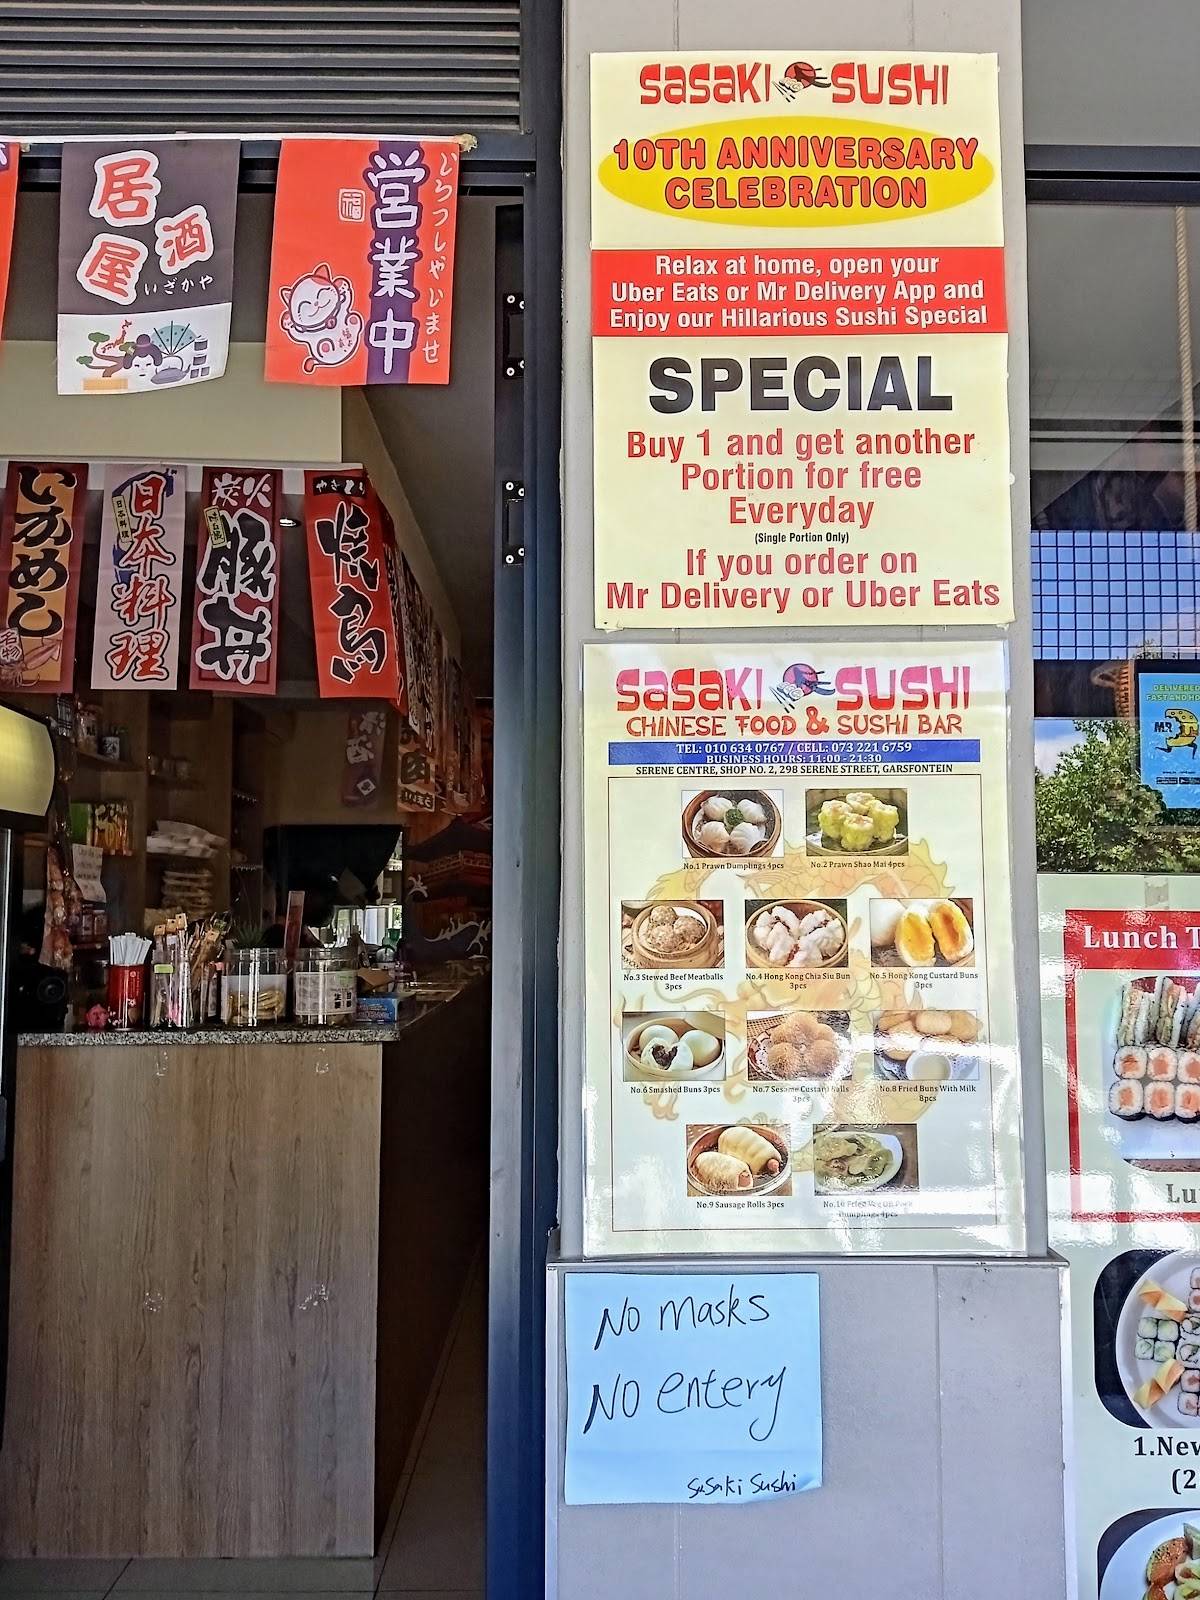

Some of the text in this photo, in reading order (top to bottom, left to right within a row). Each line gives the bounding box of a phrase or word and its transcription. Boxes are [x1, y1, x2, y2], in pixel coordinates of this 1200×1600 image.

[831, 64, 948, 105] SUSHI
[614, 136, 979, 170] 10TH ANNIVERSARY
[665, 176, 927, 208] CELEBRATION
[367, 149, 428, 376] 営業中
[656, 255, 939, 279] Relax at home, open your
[144, 274, 214, 296] いざかや
[612, 280, 984, 305] Uber Eats or Mr Delivery App and
[610, 306, 987, 332] Enjoy our Hillarious Sushi Special
[649, 355, 953, 414] SPECIAL
[627, 429, 975, 462] Buy 1 and get another
[682, 461, 921, 490] Portion for free
[730, 496, 874, 529] Everyday
[754, 532, 849, 544] (Single Portion Only)
[8, 465, 77, 638] いかめし
[105, 473, 176, 681] 日本料理
[687, 548, 917, 581] If you order on
[607, 580, 1000, 613] Mr Delivery or Uber Eats
[836, 666, 970, 711] SUSHI
[627, 706, 962, 737] CHINESE FOOD & SUSHI BAR
[676, 742, 912, 753] TEL: 010 634 0767 CELL: 073 221 6759
[707, 754, 882, 764] BUSINESS HOURS: 11:00 21:30
[677, 766, 718, 775] CENTRE,
[720, 766, 746, 774] SHOP
[750, 766, 766, 774] NO.
[769, 766, 777, 775] 2,
[800, 765, 838, 773] SERENE
[841, 765, 880, 774] STREET,
[883, 764, 952, 773] GARSFONTEIN
[727, 862, 766, 870] Dumplings
[768, 862, 784, 870] 4pcs
[1084, 925, 1178, 949] Lunch
[665, 983, 682, 991] 3pcs
[764, 973, 783, 981] Hong
[785, 973, 804, 981] Kong
[790, 982, 806, 990] 3pcs
[889, 972, 908, 980] Hong
[909, 972, 928, 980] Kong
[631, 1086, 647, 1094] No.6
[704, 1086, 720, 1094] 3pcs
[919, 1095, 936, 1103] 8pcs
[696, 1201, 713, 1209] No.9
[715, 1201, 745, 1209] Sausage
[767, 1201, 784, 1209] 3pcs
[657, 1366, 786, 1441] entery
[750, 1470, 796, 1494] Sushi
[1172, 1468, 1197, 1495] (2
